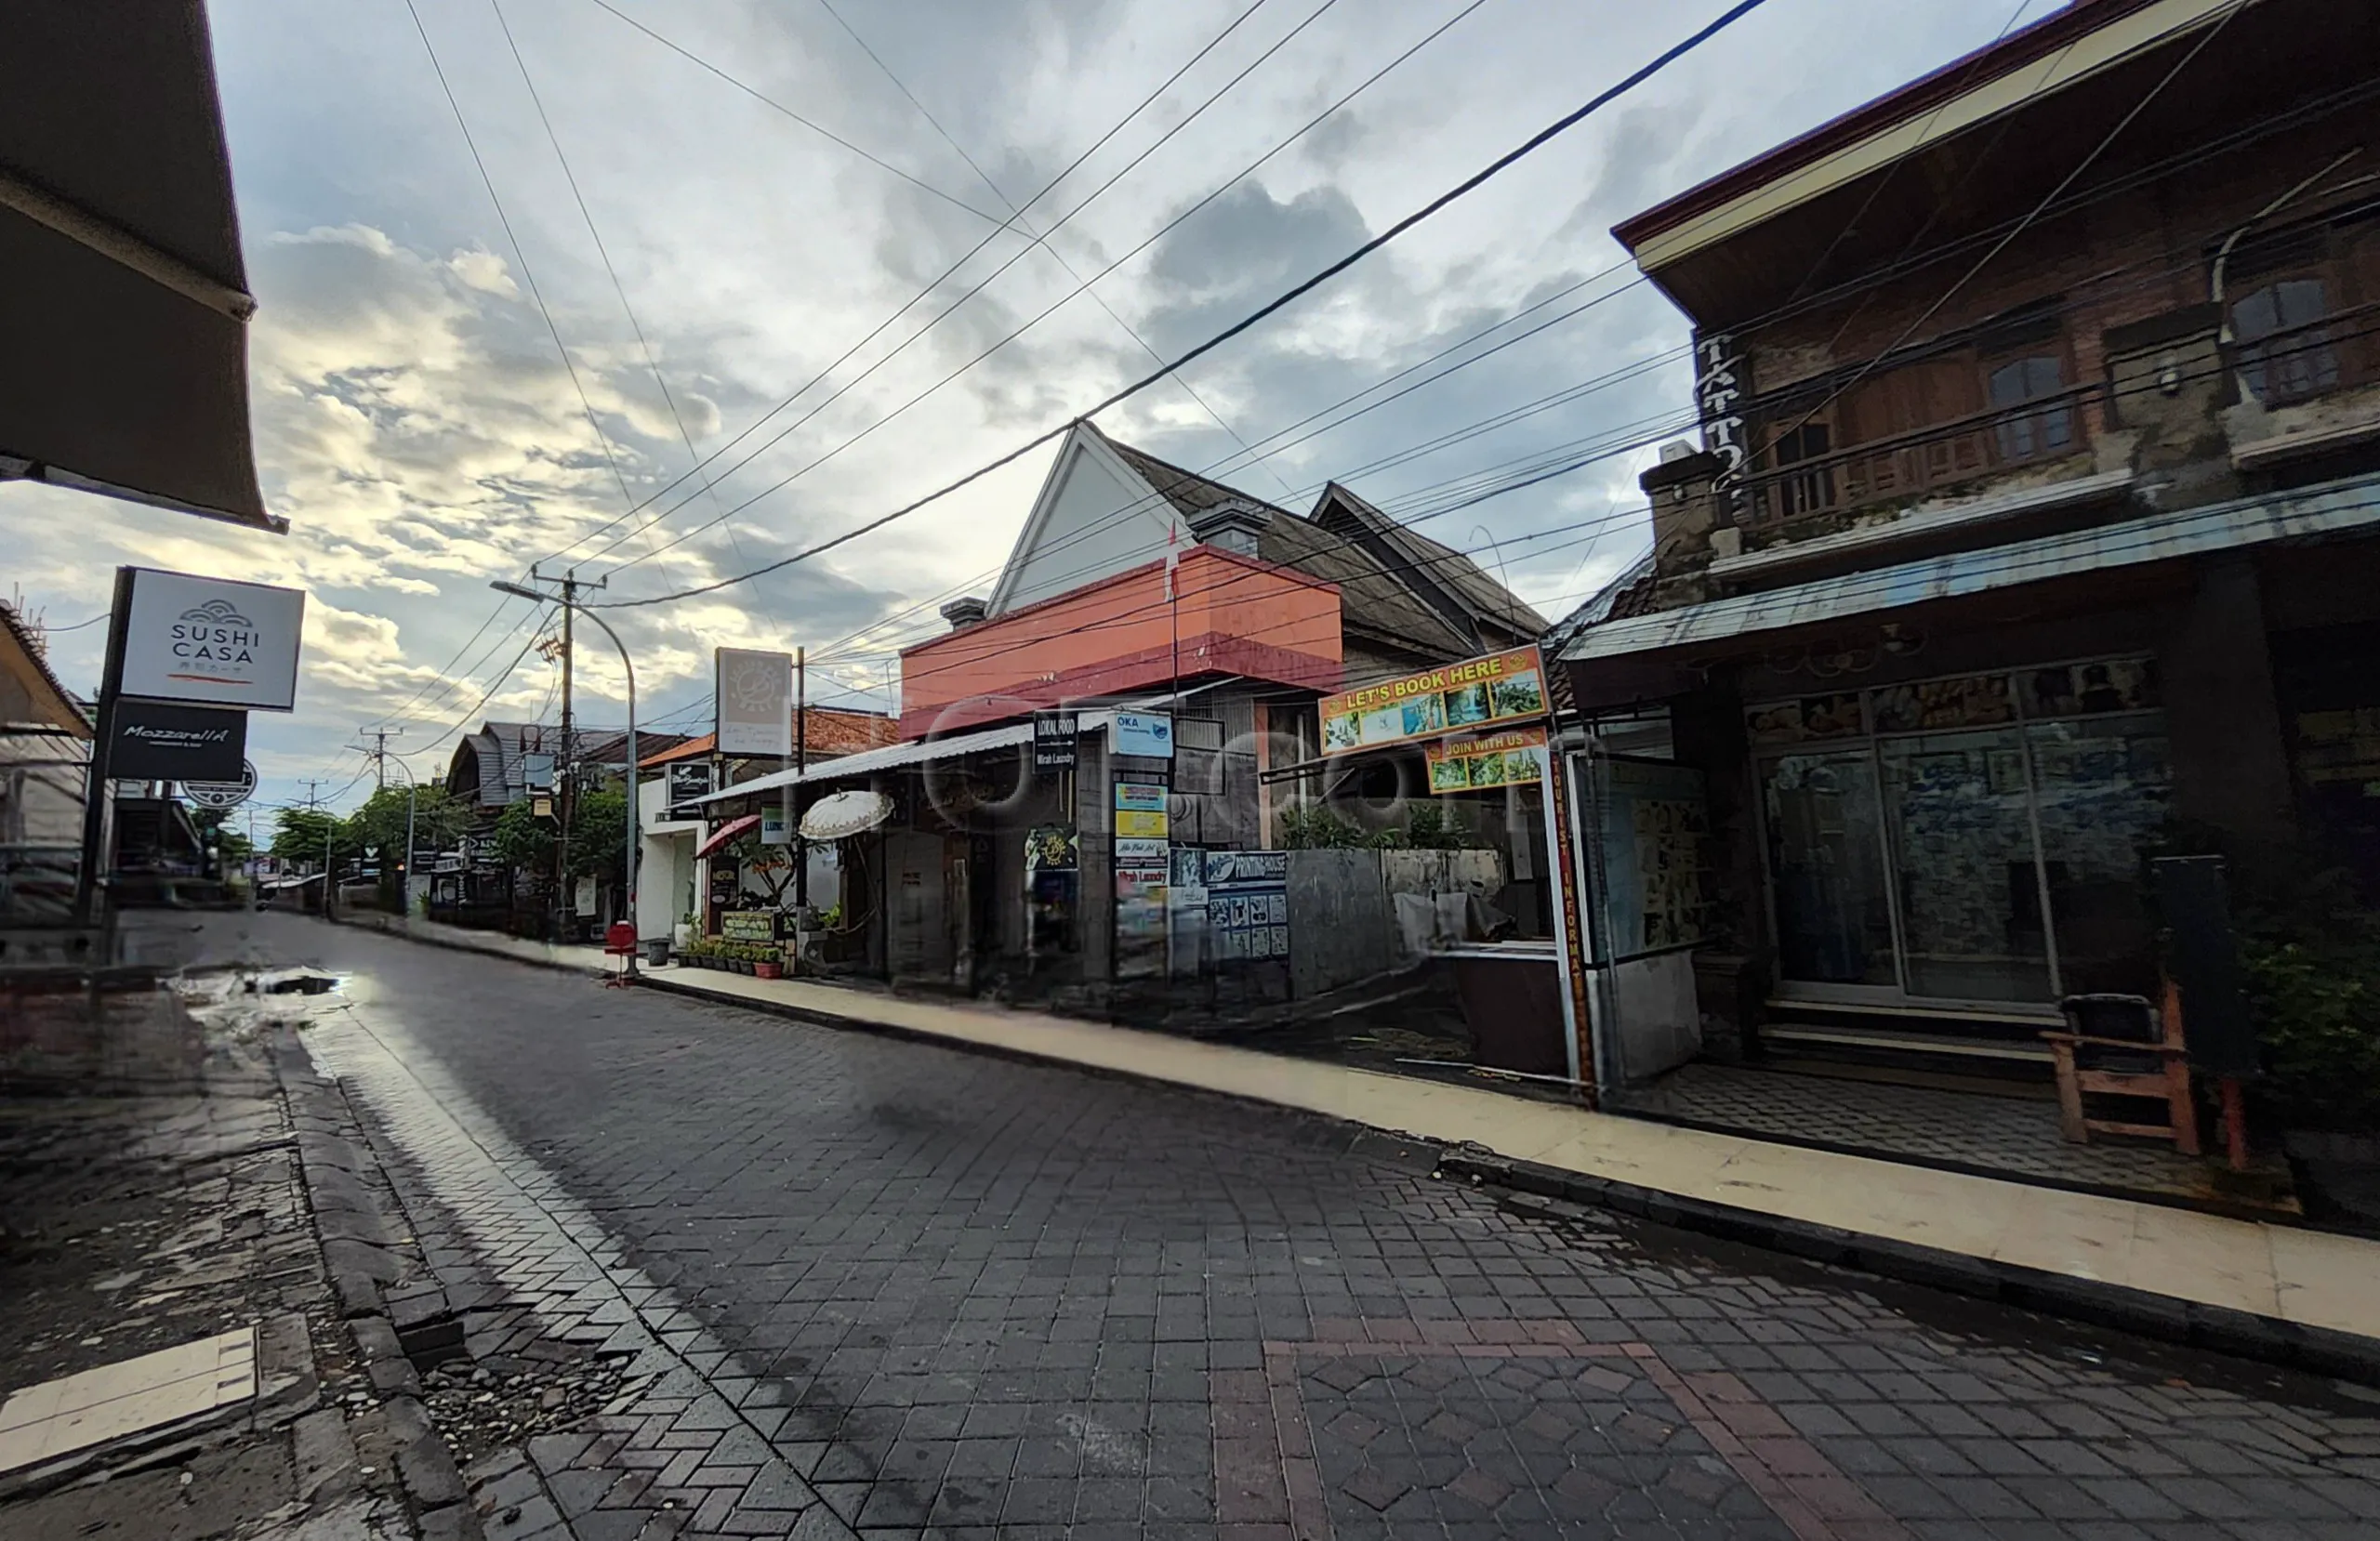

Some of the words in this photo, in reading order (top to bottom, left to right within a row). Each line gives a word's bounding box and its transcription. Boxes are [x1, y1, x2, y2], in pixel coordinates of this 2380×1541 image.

[1697, 334, 1745, 511] TATTO
[171, 624, 259, 648] SUSHI
[173, 642, 253, 664] CASA
[1347, 683, 1390, 708] LET'S
[1395, 671, 1446, 696] BOOK
[1450, 658, 1502, 683] HERE
[1038, 719, 1057, 736] LOKAL
[1058, 718, 1076, 735] FOOD
[1117, 717, 1139, 727] OKA
[1446, 741, 1472, 756] JOIN
[1474, 736, 1504, 751] WITH
[1507, 734, 1523, 746] US
[1552, 760, 1568, 855] TOURIST
